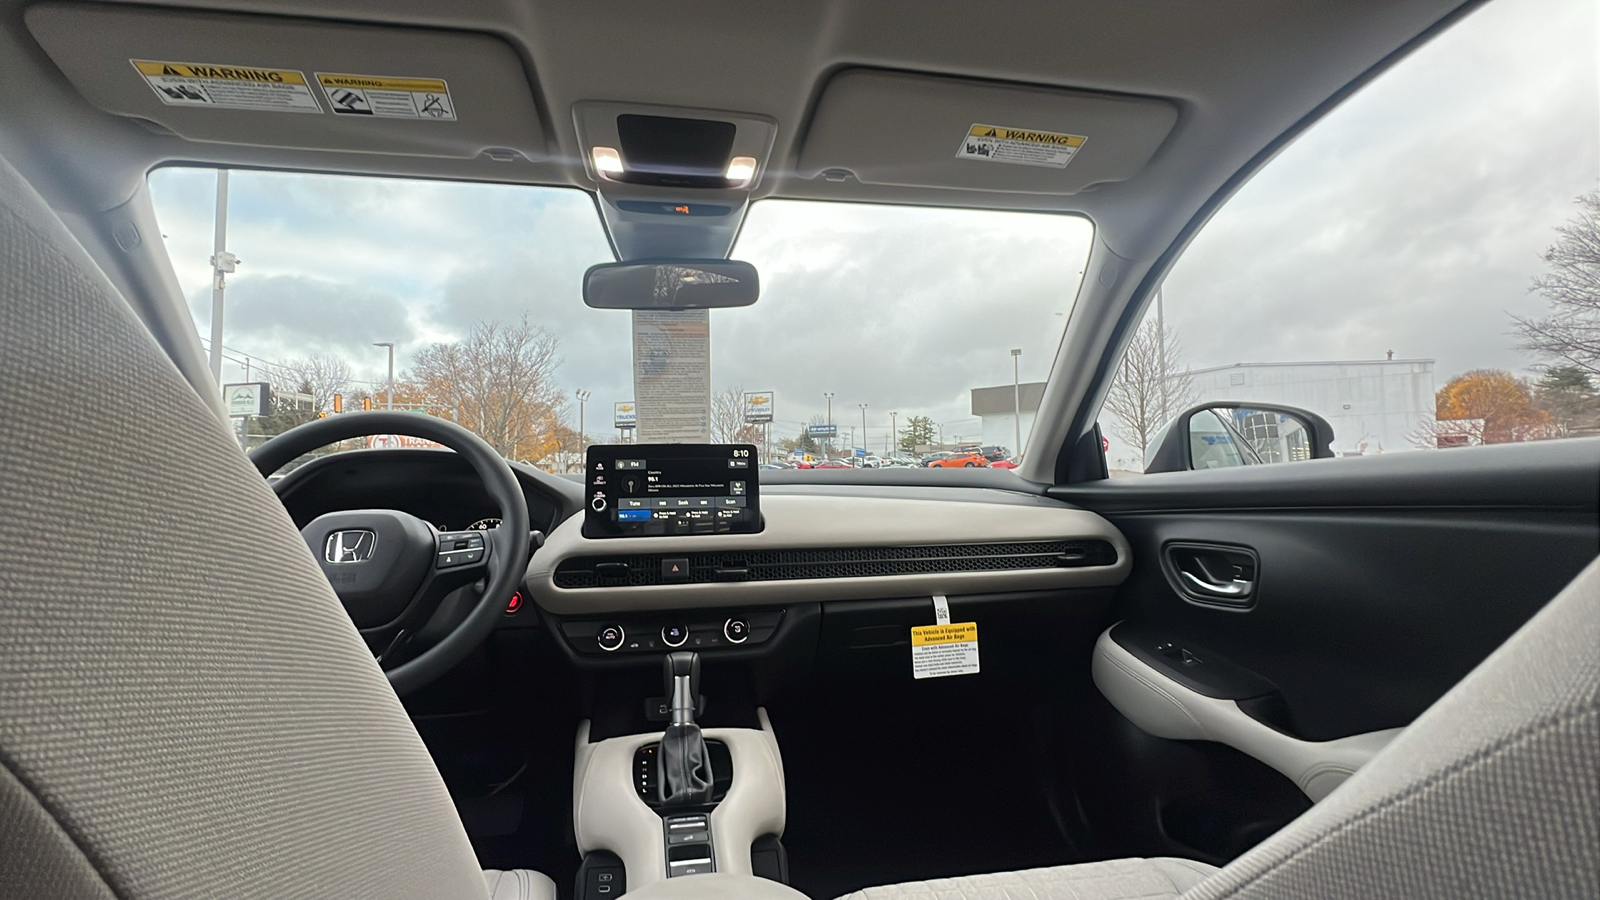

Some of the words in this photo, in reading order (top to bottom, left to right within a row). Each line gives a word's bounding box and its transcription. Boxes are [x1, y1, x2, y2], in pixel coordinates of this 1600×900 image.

[186, 66, 283, 82] WARNING
[334, 78, 382, 87] WARNING
[1005, 130, 1069, 145] WARNING
[733, 449, 749, 457] 8:10
